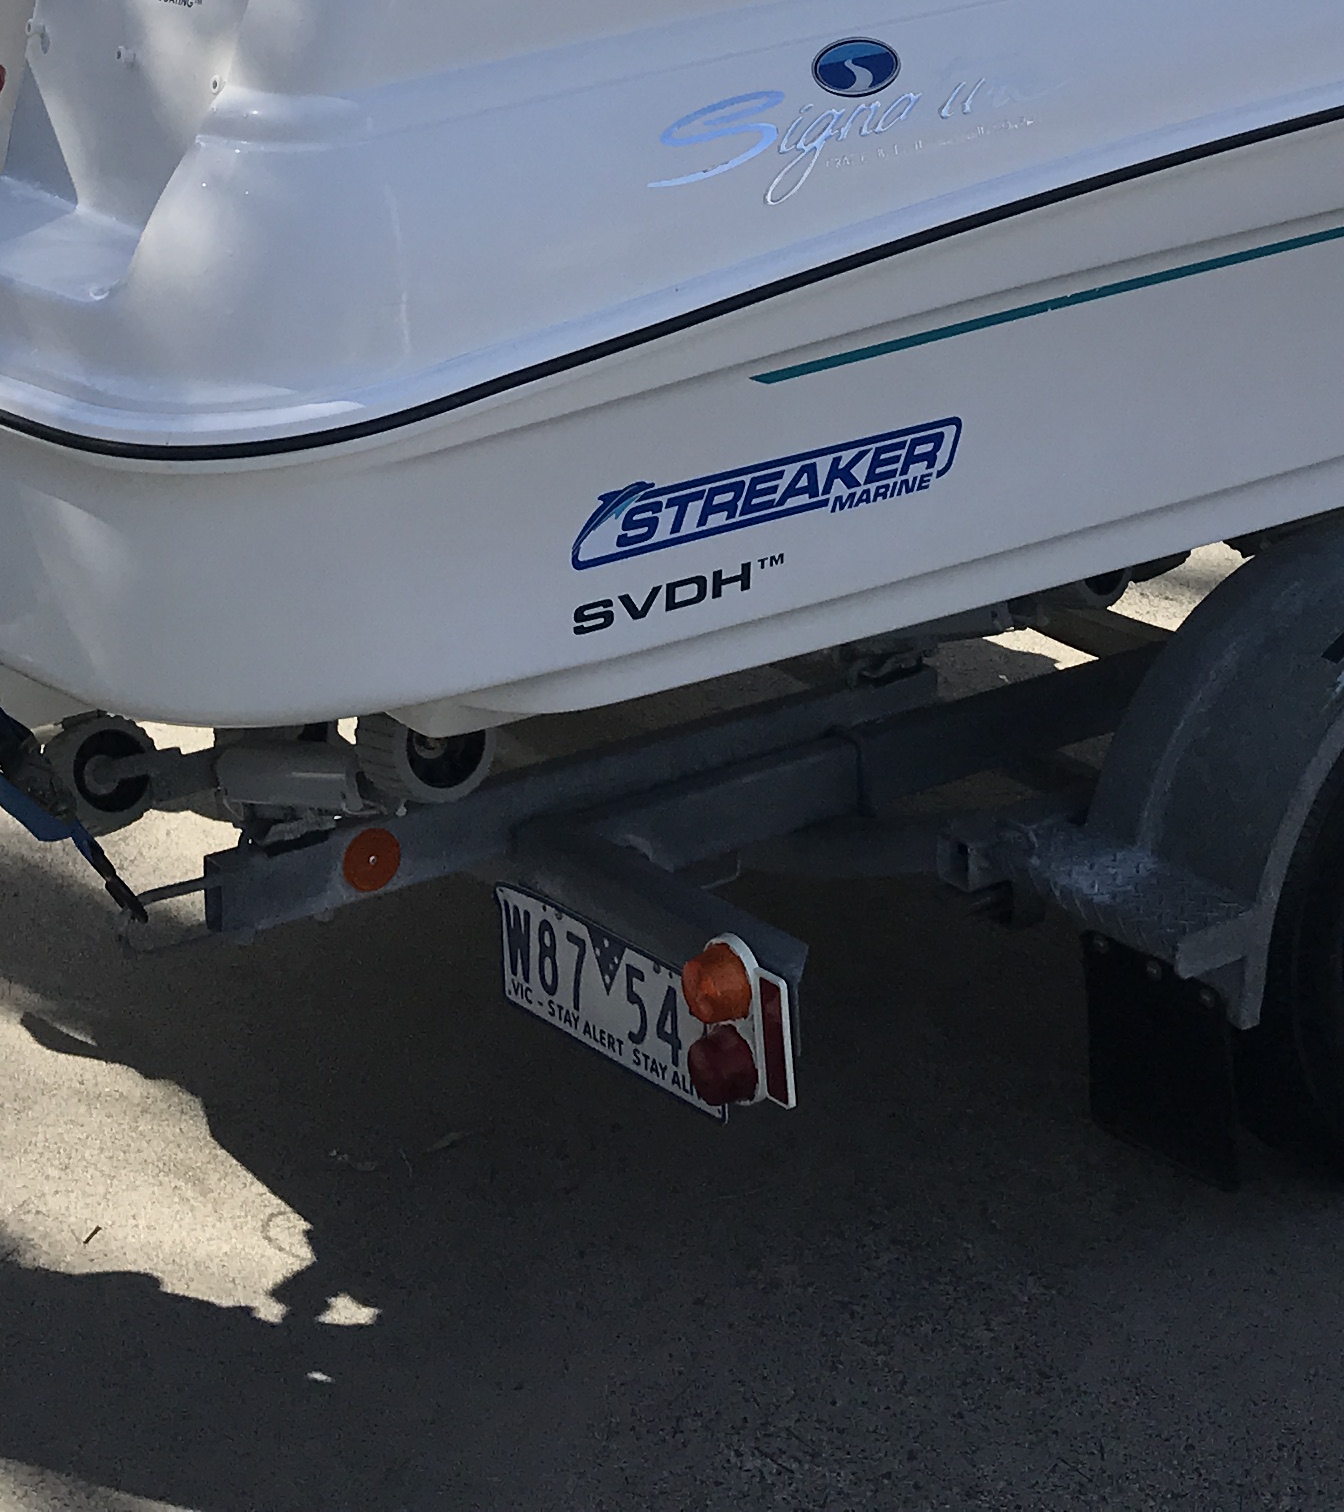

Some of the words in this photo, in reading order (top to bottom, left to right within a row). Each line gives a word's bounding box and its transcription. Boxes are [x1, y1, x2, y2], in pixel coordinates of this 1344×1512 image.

[615, 431, 945, 548] STREAKER
[830, 473, 932, 514] MARINE
[504, 899, 587, 1012] W87
[511, 977, 533, 1004] VIC
[548, 999, 580, 1030] STAY
[582, 1020, 624, 1057] ALERT
[632, 1047, 667, 1082] STAY
